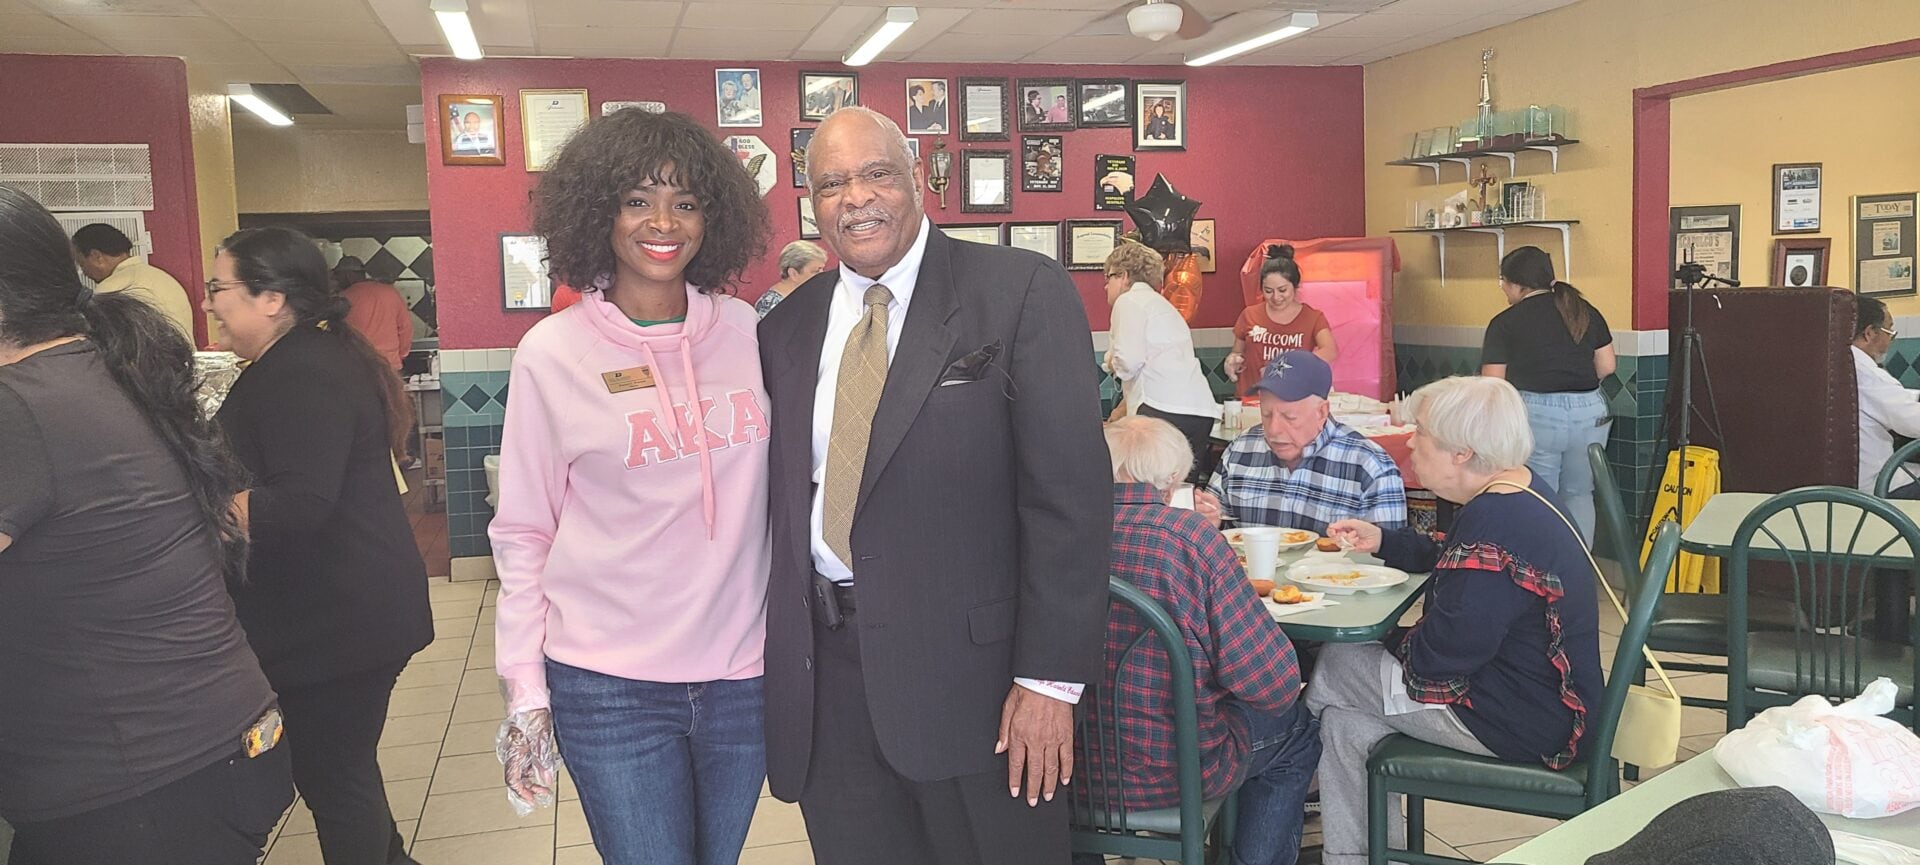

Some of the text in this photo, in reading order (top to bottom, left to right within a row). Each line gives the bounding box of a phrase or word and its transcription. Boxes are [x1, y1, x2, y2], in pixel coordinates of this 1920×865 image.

[1874, 202, 1900, 213] TODAY
[1253, 333, 1304, 347] WELCOME
[1263, 346, 1295, 360] HO
[624, 389, 769, 470] AKA
[1664, 483, 1692, 496] CAUON
